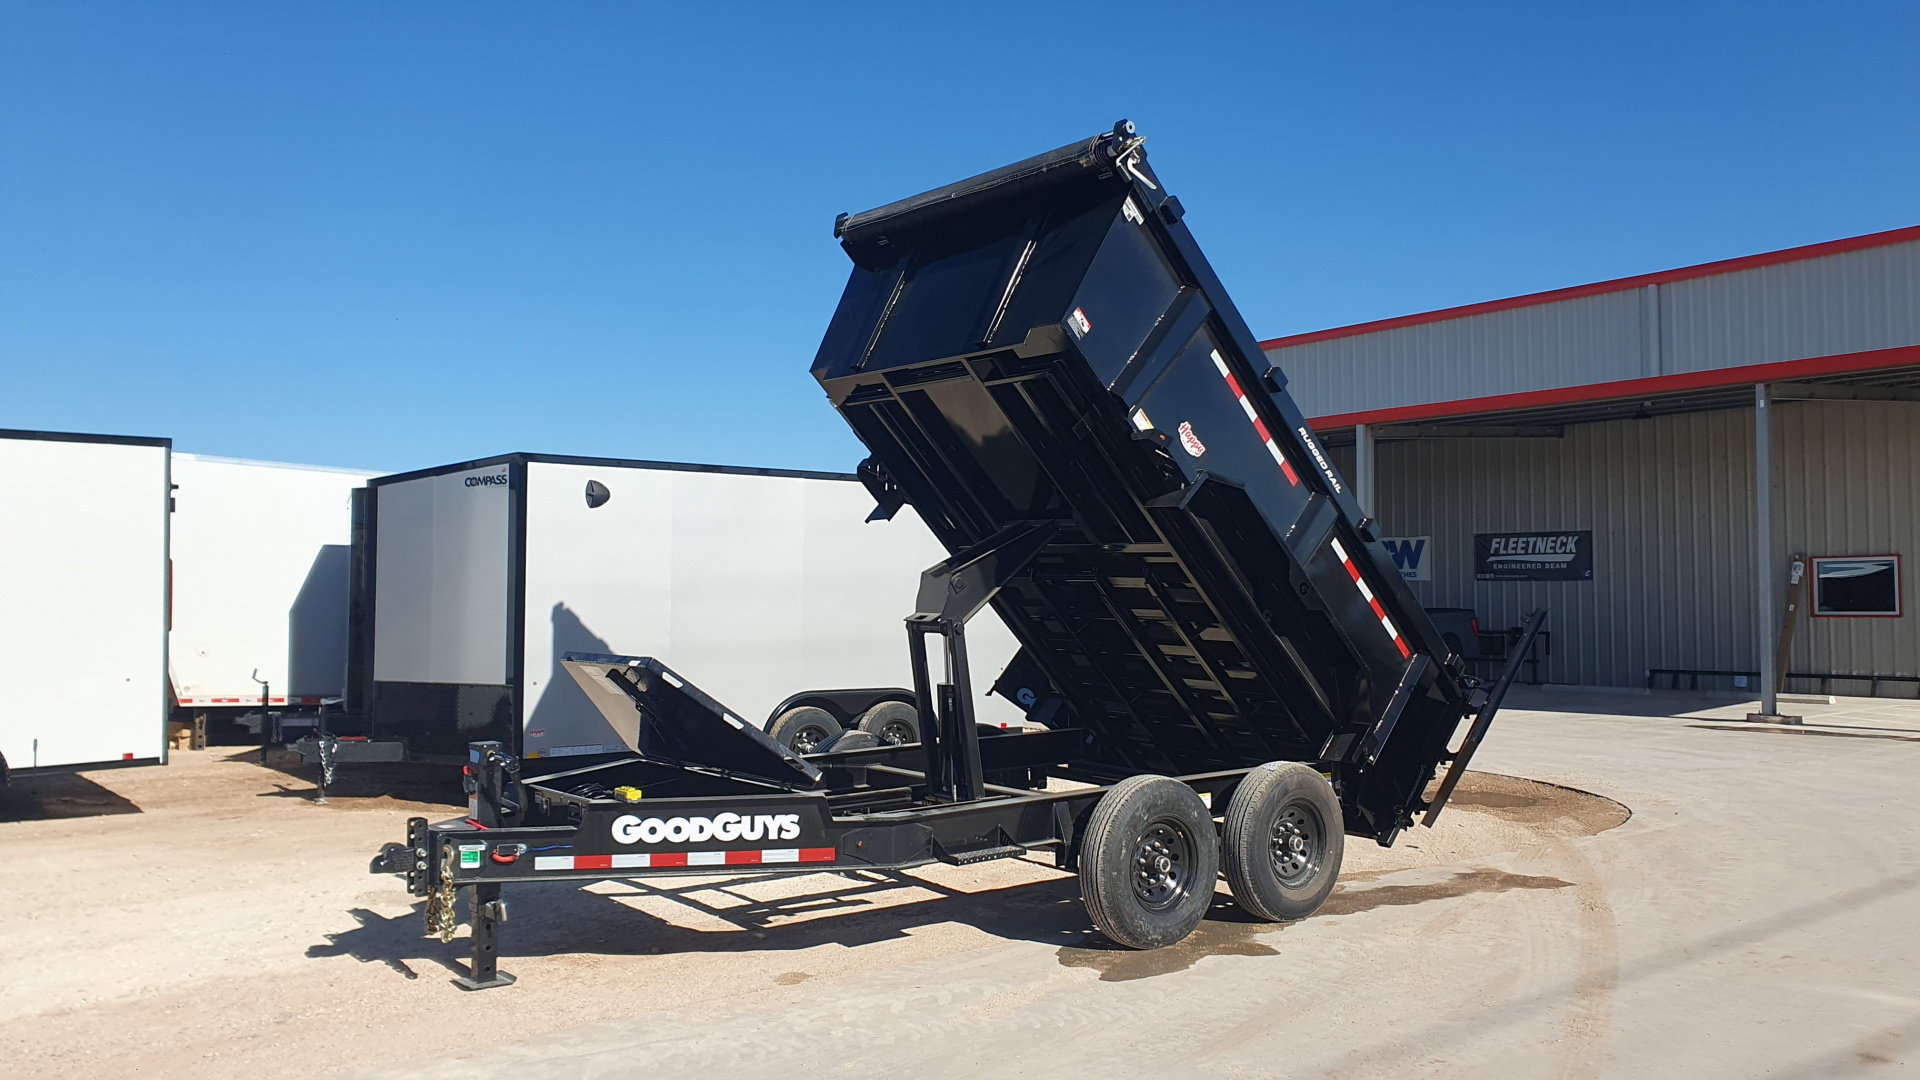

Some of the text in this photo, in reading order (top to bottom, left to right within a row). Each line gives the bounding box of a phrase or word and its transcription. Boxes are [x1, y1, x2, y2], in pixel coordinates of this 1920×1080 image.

[1180, 423, 1204, 456] Happy
[1298, 427, 1342, 494] RUGGED RAIL
[464, 474, 508, 488] COMPASS
[1490, 535, 1579, 554] FLEETNECK
[1493, 562, 1542, 570] ENGINEERED
[611, 811, 801, 844] GOODGUYS
